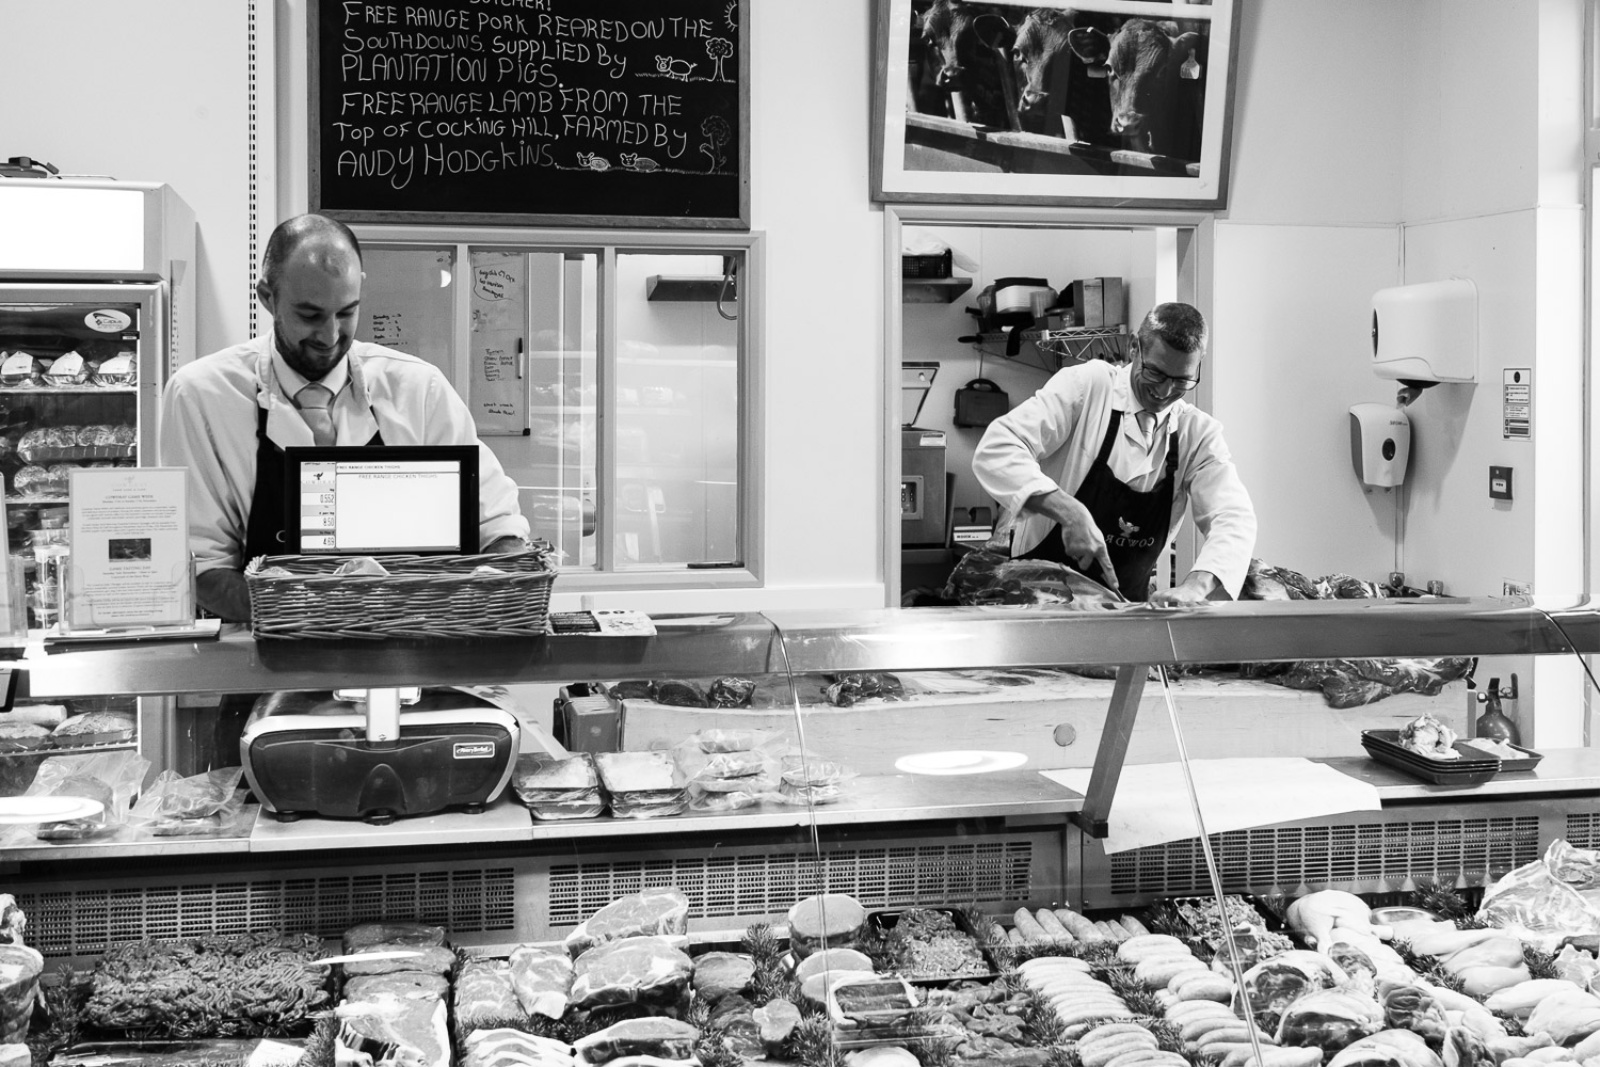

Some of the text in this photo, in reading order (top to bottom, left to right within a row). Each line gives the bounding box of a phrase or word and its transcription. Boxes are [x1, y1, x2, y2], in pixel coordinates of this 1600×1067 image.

[342, 1, 398, 25] FREE
[405, 6, 470, 30] RANGE
[478, 12, 529, 35] PORK
[669, 16, 714, 38] THE
[491, 35, 591, 63] SUPPLIED
[341, 52, 488, 82] PLANTATION
[341, 87, 683, 117] FREE RANGE LAMB FROM THE
[417, 116, 507, 139] COCKING
[562, 114, 650, 145] FARMED
[337, 145, 414, 190] ANDY
